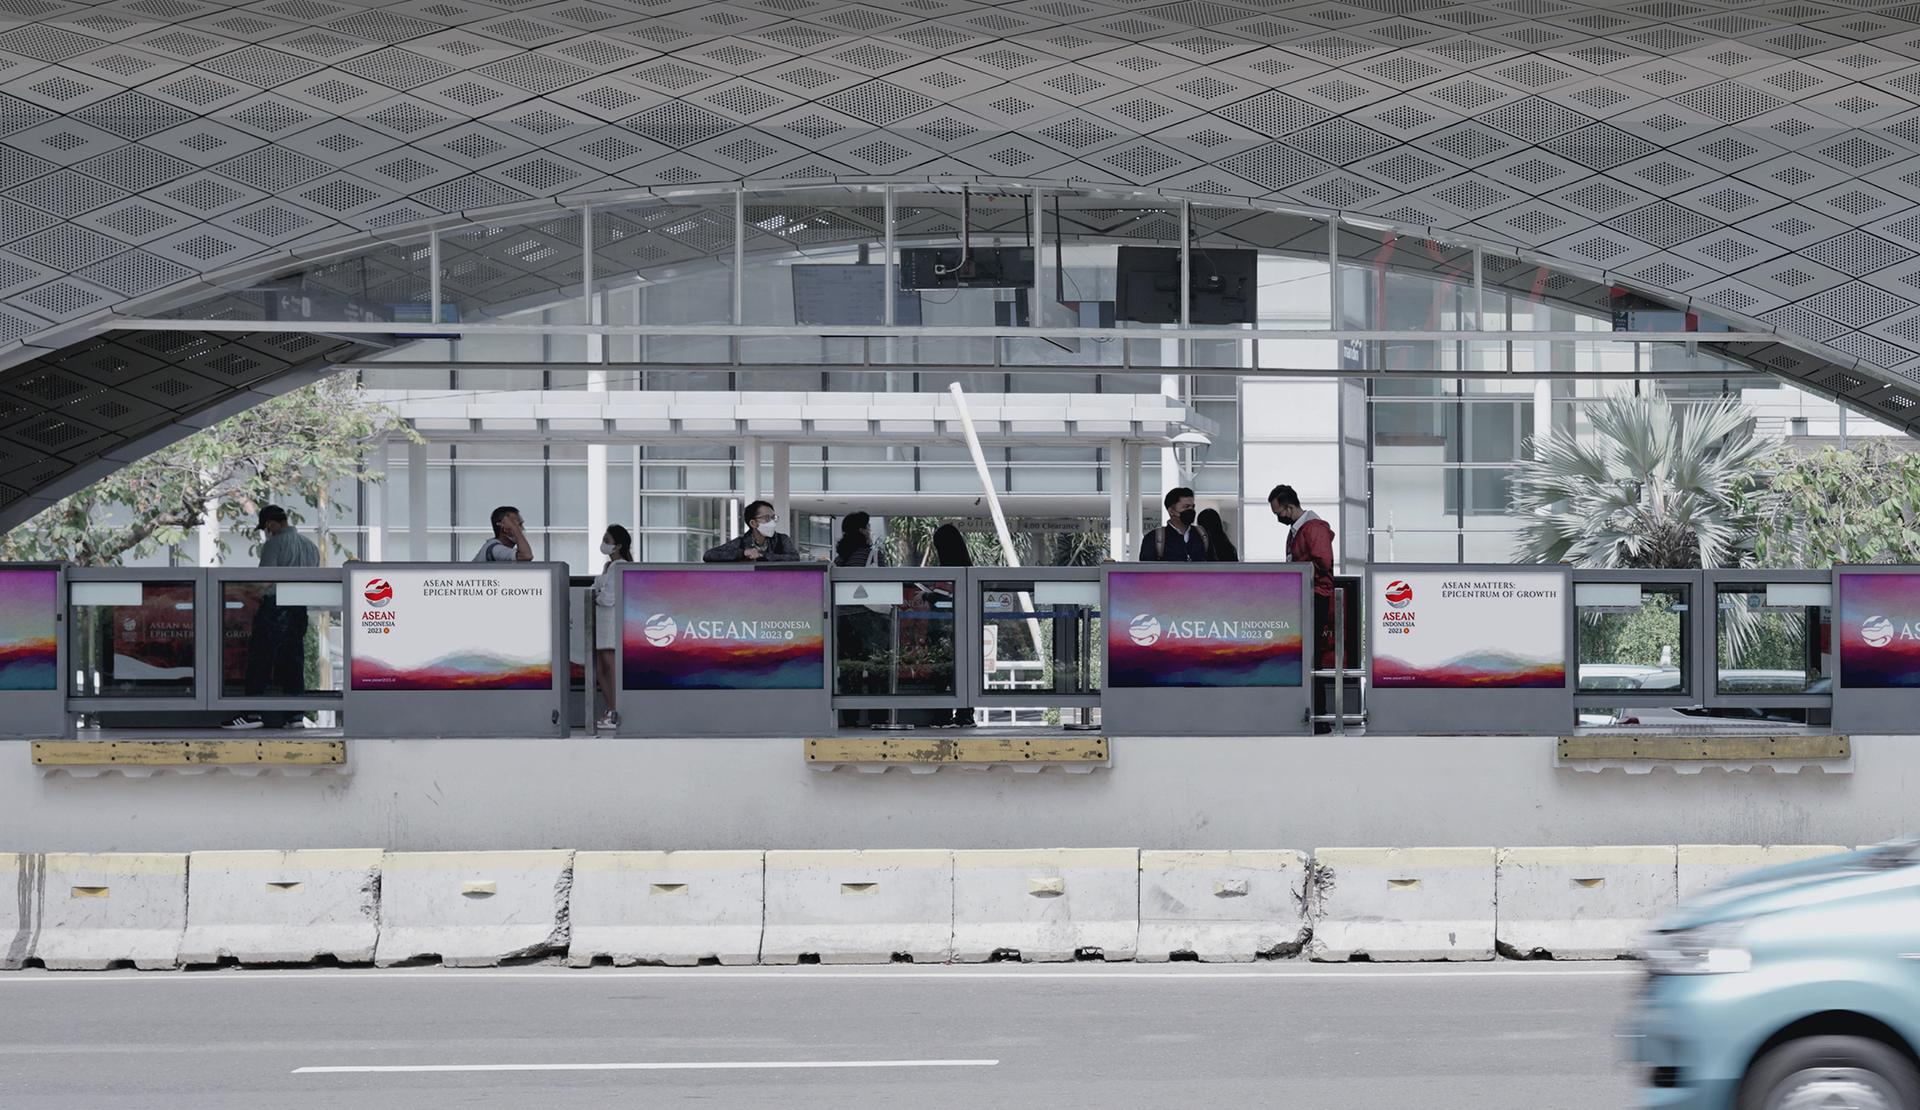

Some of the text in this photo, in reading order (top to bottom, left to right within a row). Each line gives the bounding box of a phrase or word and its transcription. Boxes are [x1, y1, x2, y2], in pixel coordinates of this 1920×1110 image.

[958, 520, 1013, 528] pullmn
[362, 611, 396, 620] ASEAN
[1382, 612, 1415, 621] ASEAN
[760, 621, 811, 629] INDONESIA
[1241, 620, 1290, 629] INDONESIA
[683, 621, 757, 640] ASEAN
[1166, 620, 1239, 639] ASEAN
[760, 631, 782, 640] 2023
[1241, 630, 1262, 639] 2023
